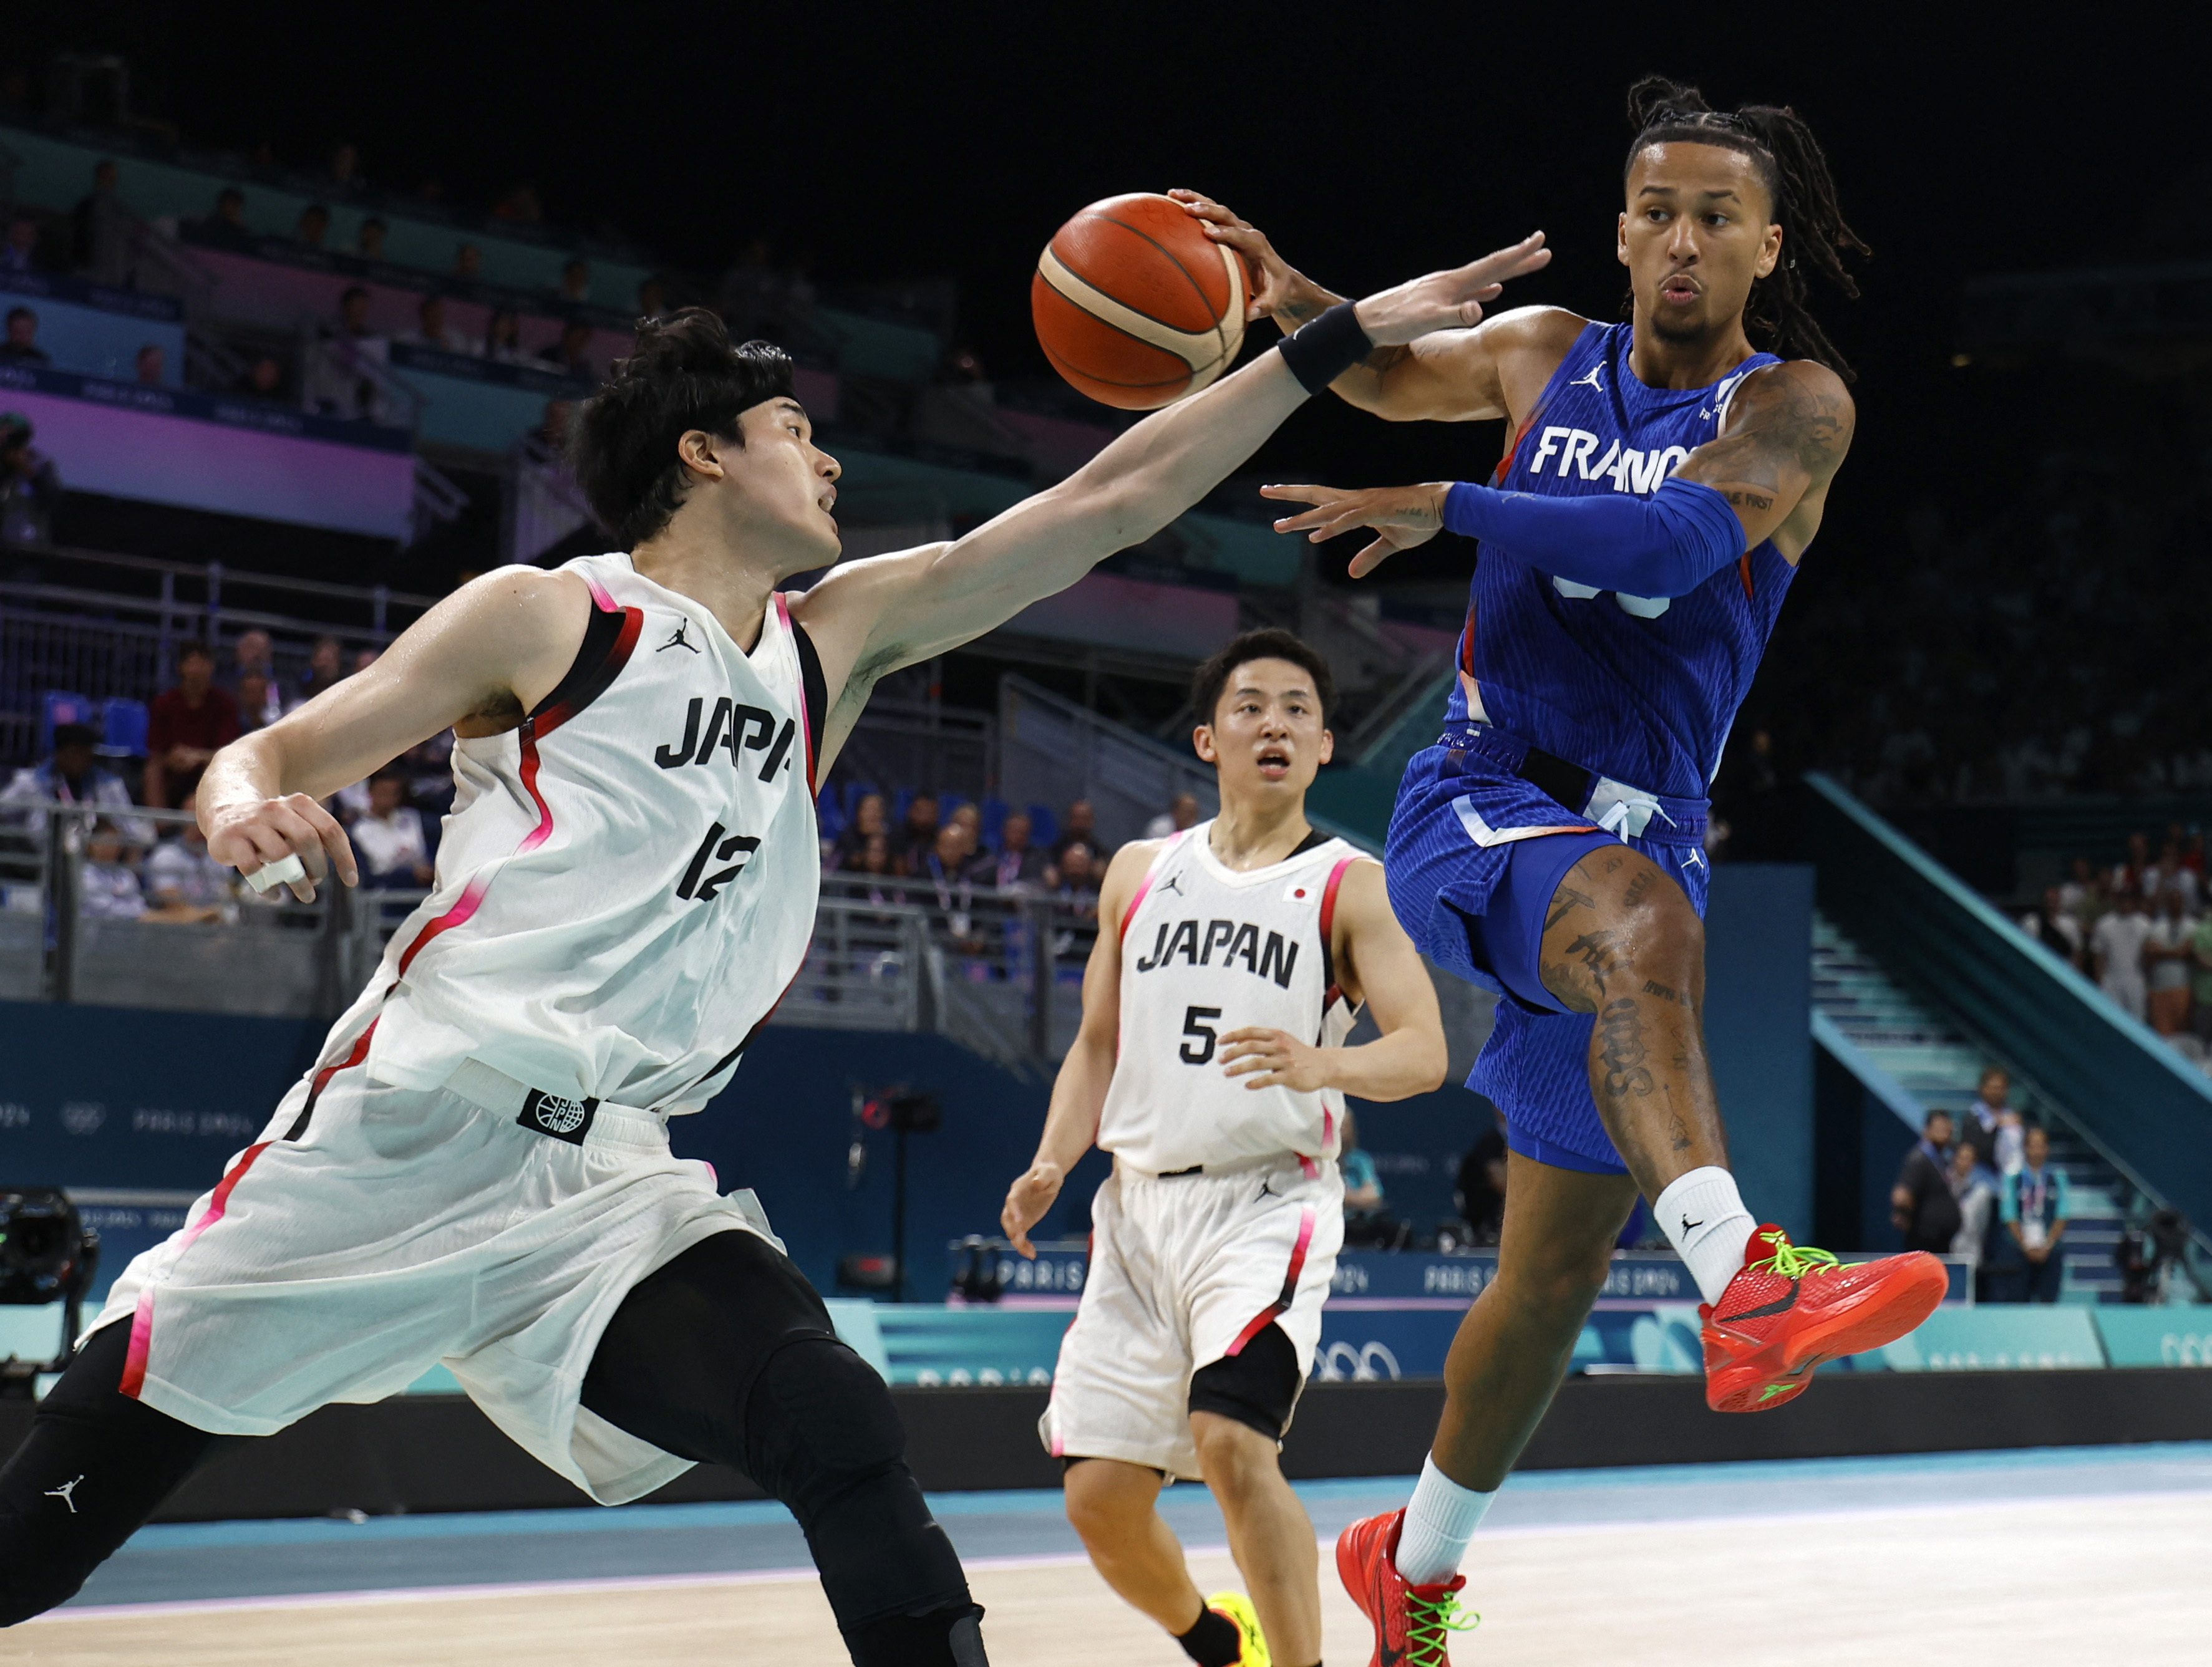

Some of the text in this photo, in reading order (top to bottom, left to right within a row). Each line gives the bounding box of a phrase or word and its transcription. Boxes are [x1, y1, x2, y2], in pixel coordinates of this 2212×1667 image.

[1530, 426, 1700, 494] FRANC
[655, 697, 795, 783] JAPA
[676, 821, 761, 902] 12
[1137, 920, 1299, 990] JAPAN
[1179, 1005, 1222, 1065] 5
[997, 1259, 1084, 1290] PARIS
